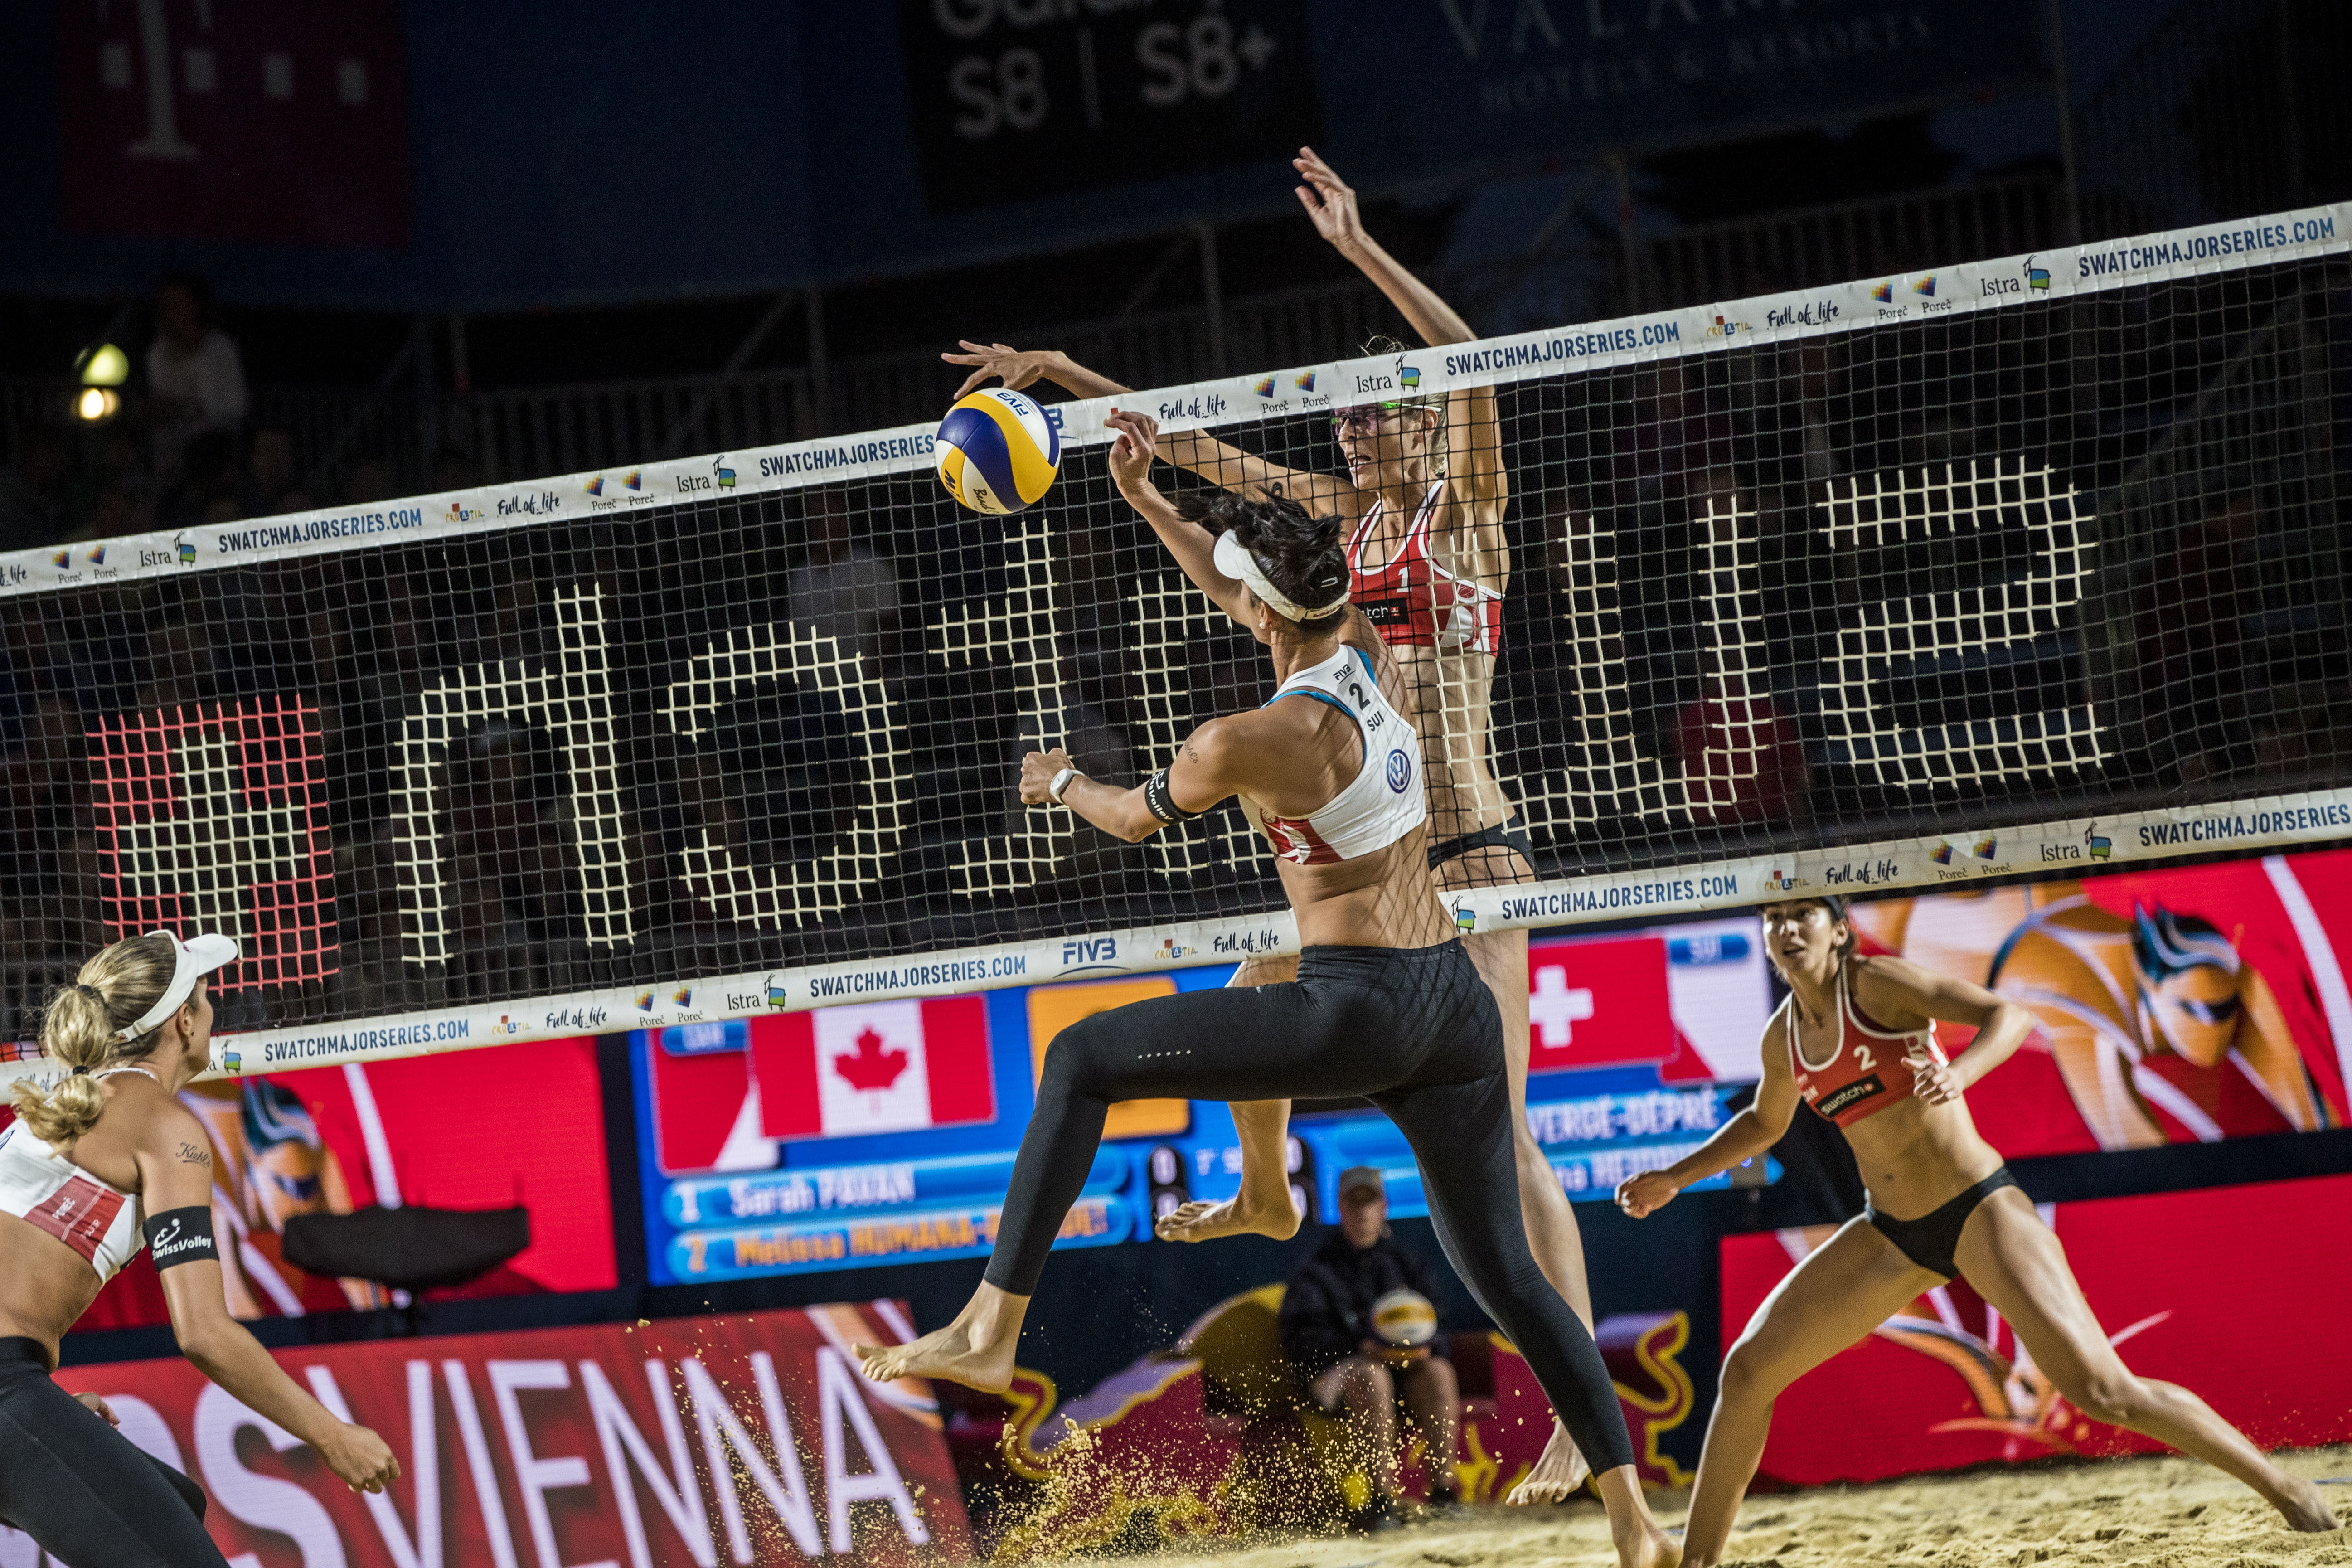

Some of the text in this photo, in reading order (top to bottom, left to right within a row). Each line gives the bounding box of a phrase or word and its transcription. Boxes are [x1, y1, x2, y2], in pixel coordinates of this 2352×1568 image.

[2078, 216, 2335, 278] SWATCHMAJORSERIES.COM
[1981, 276, 2021, 297] Istra
[1446, 322, 1680, 376] SWATCHMAJORSERIES.COM
[1356, 374, 1393, 393] Istra
[996, 393, 1029, 417] FIVB
[676, 473, 711, 493] Istra
[219, 507, 422, 553] SWATCHMAJORSERIES.COM
[139, 549, 172, 568] Istra
[1396, 566, 1412, 593] 1
[1333, 663, 1352, 680] FIVB
[1349, 682, 1371, 711] 2
[1367, 710, 1385, 732] SUI
[2041, 843, 2080, 862] Istra
[1502, 874, 1738, 920] SWATCHMAJORSERIES.COM
[1063, 937, 1117, 965] FIVB
[810, 955, 1026, 998] SWATCHMAJORSERIES.COM
[727, 992, 761, 1011] Istra
[265, 1019, 470, 1062] SWATCHMAJORSERIES.COM
[1853, 1044, 1877, 1072] 2
[1820, 1085, 1866, 1116] swatch
[152, 1235, 212, 1261] SwissVolley
